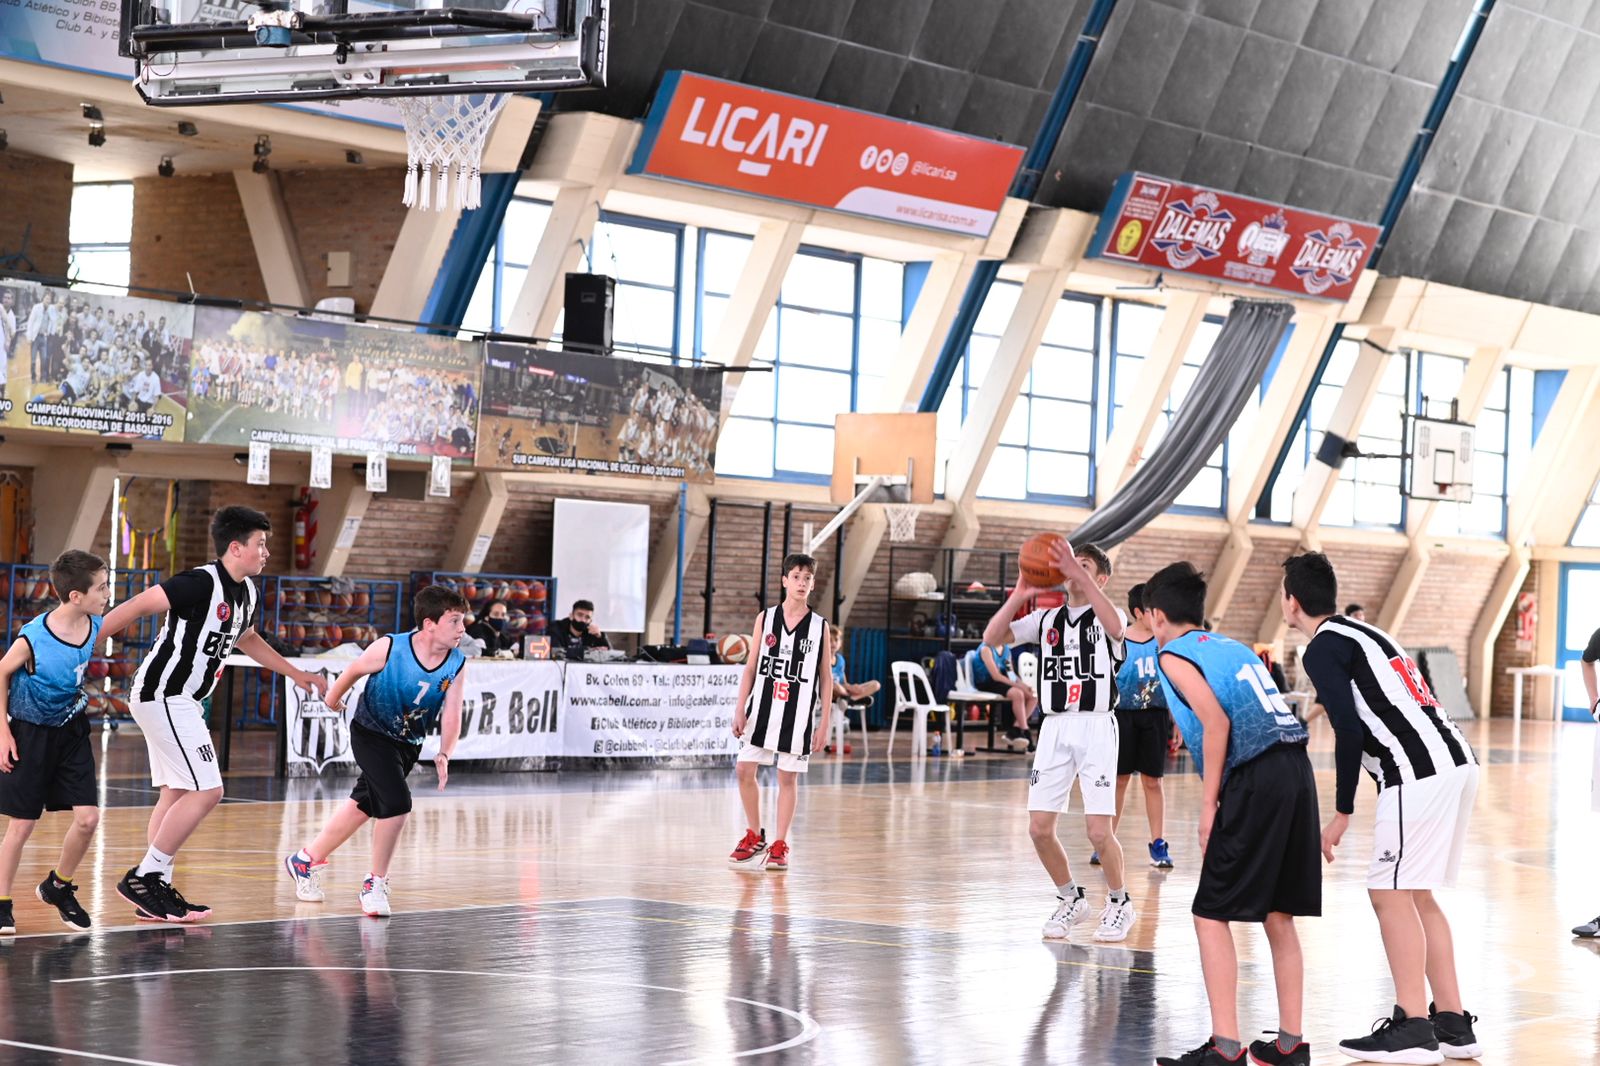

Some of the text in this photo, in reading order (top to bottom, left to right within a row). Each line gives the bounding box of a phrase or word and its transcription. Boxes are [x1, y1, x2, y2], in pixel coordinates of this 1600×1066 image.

[73, 11, 80, 20] y
[55, 19, 82, 33] Club
[84, 28, 97, 36] A.
[100, 31, 107, 40] y
[680, 96, 829, 168] LICARI
[1154, 208, 1233, 251] DALEMAS
[1292, 238, 1364, 279] DALEMAS
[25, 402, 70, 416] CAMPEÓN
[71, 406, 124, 421] PROVINCIAL
[125, 411, 146, 423] 2015
[151, 414, 173, 426] 2016
[32, 414, 165, 436] LIGA CORDOBESA DE BASQUET
[250, 429, 290, 444] CAMPEÓN
[561, 458, 577, 468] LIGA
[577, 459, 610, 471] NACIONAL
[620, 463, 641, 474] VOLEY
[758, 655, 809, 683] BELL
[1044, 656, 1104, 681] BELL
[1134, 656, 1157, 679] 14
[586, 673, 600, 686] Bv.
[412, 680, 431, 705] 7
[570, 694, 661, 707] www.cabell.com.ar
[773, 681, 790, 702] 15
[1068, 684, 1081, 704] 8
[477, 691, 502, 735] B.
[508, 690, 559, 734] Bell
[600, 717, 620, 730] Club
[622, 717, 658, 730] Atlético
[658, 721, 665, 732] y
[667, 717, 712, 729] Biblioteca
